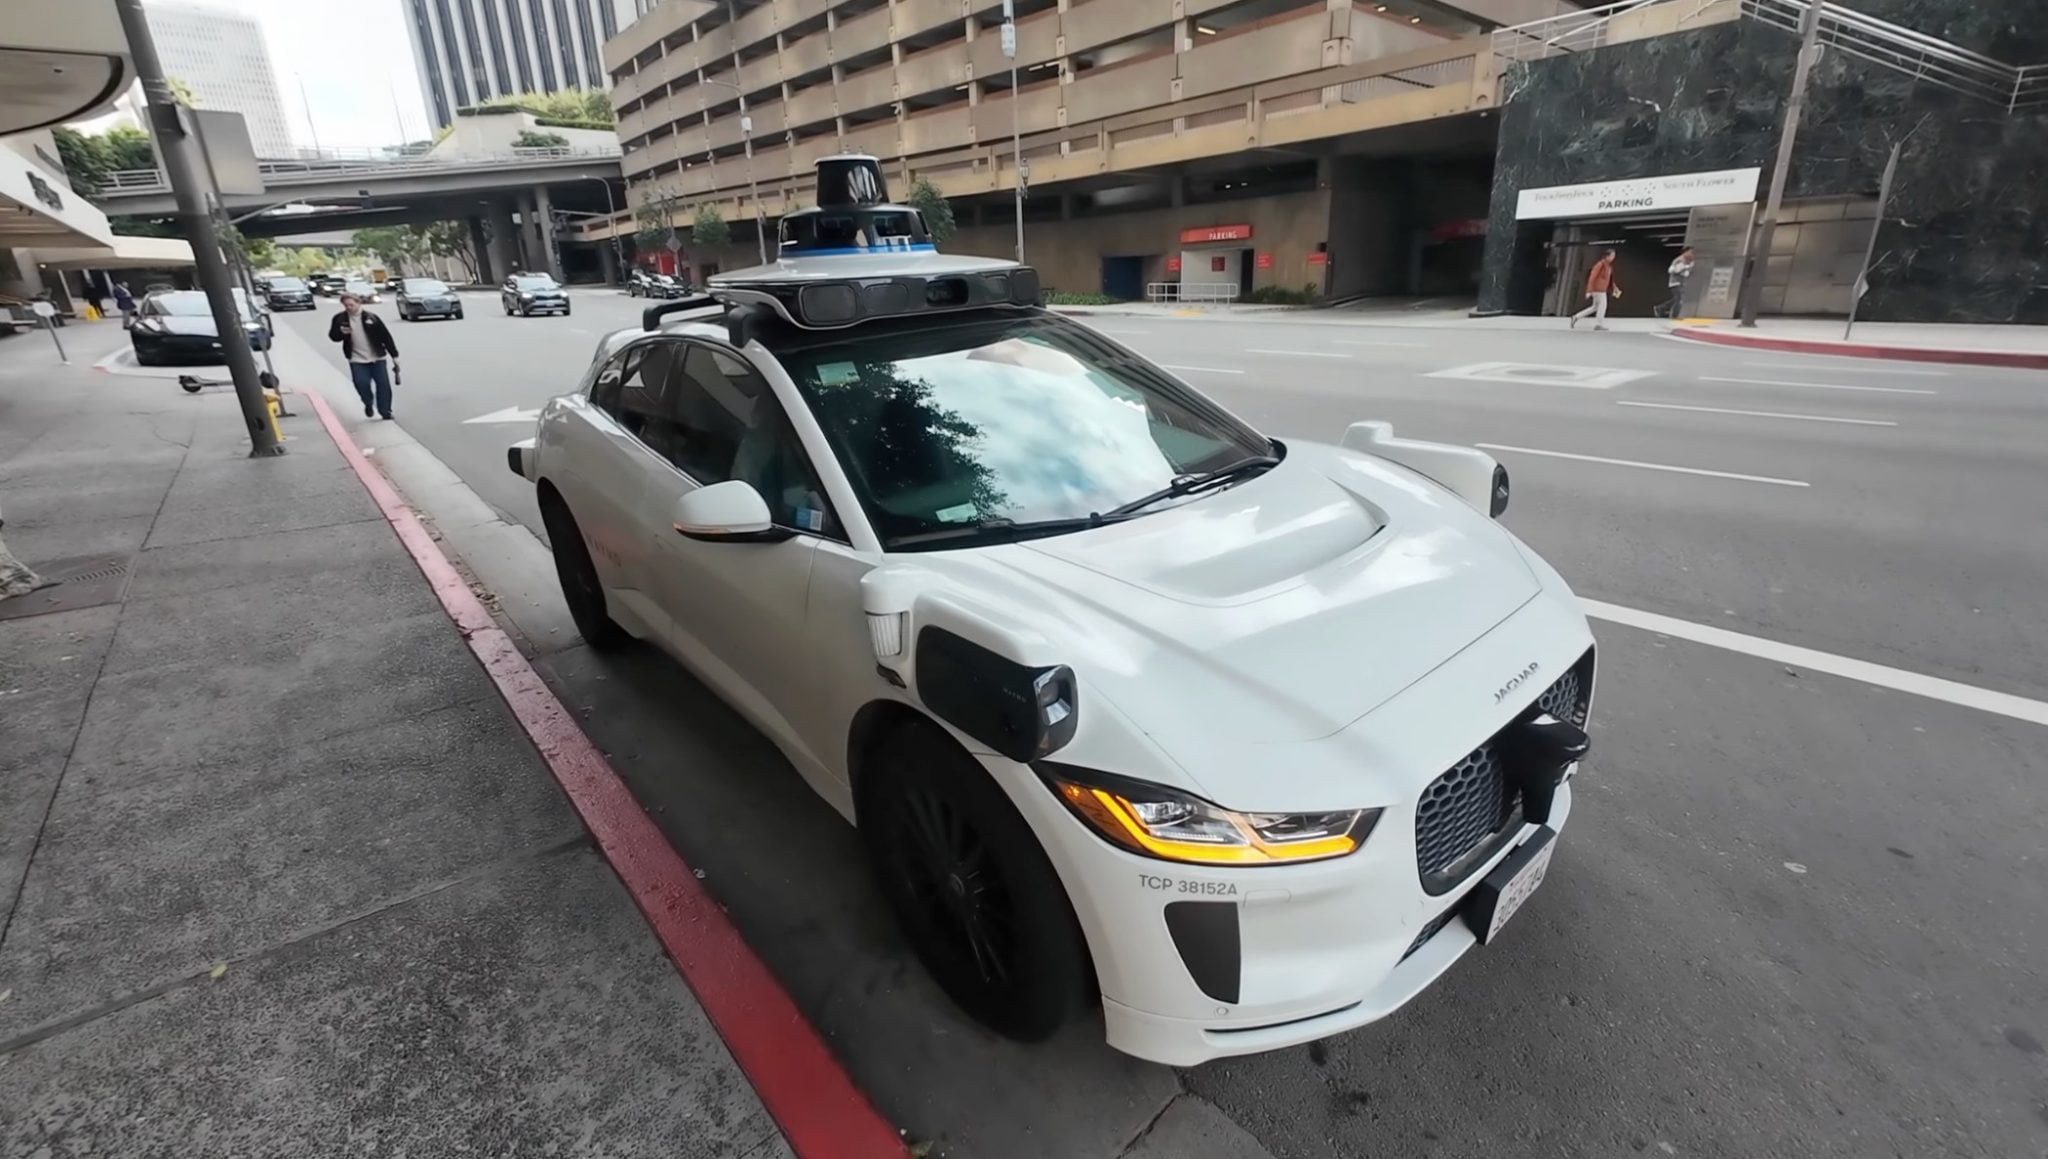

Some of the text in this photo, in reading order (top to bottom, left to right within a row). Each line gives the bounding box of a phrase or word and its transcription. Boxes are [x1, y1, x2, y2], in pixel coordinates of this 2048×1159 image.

[1598, 197, 1653, 209] PARKING
[1208, 230, 1238, 241] PARKING
[1493, 661, 1540, 706] JAGUAR
[1138, 873, 1239, 896] TCP 38152A
